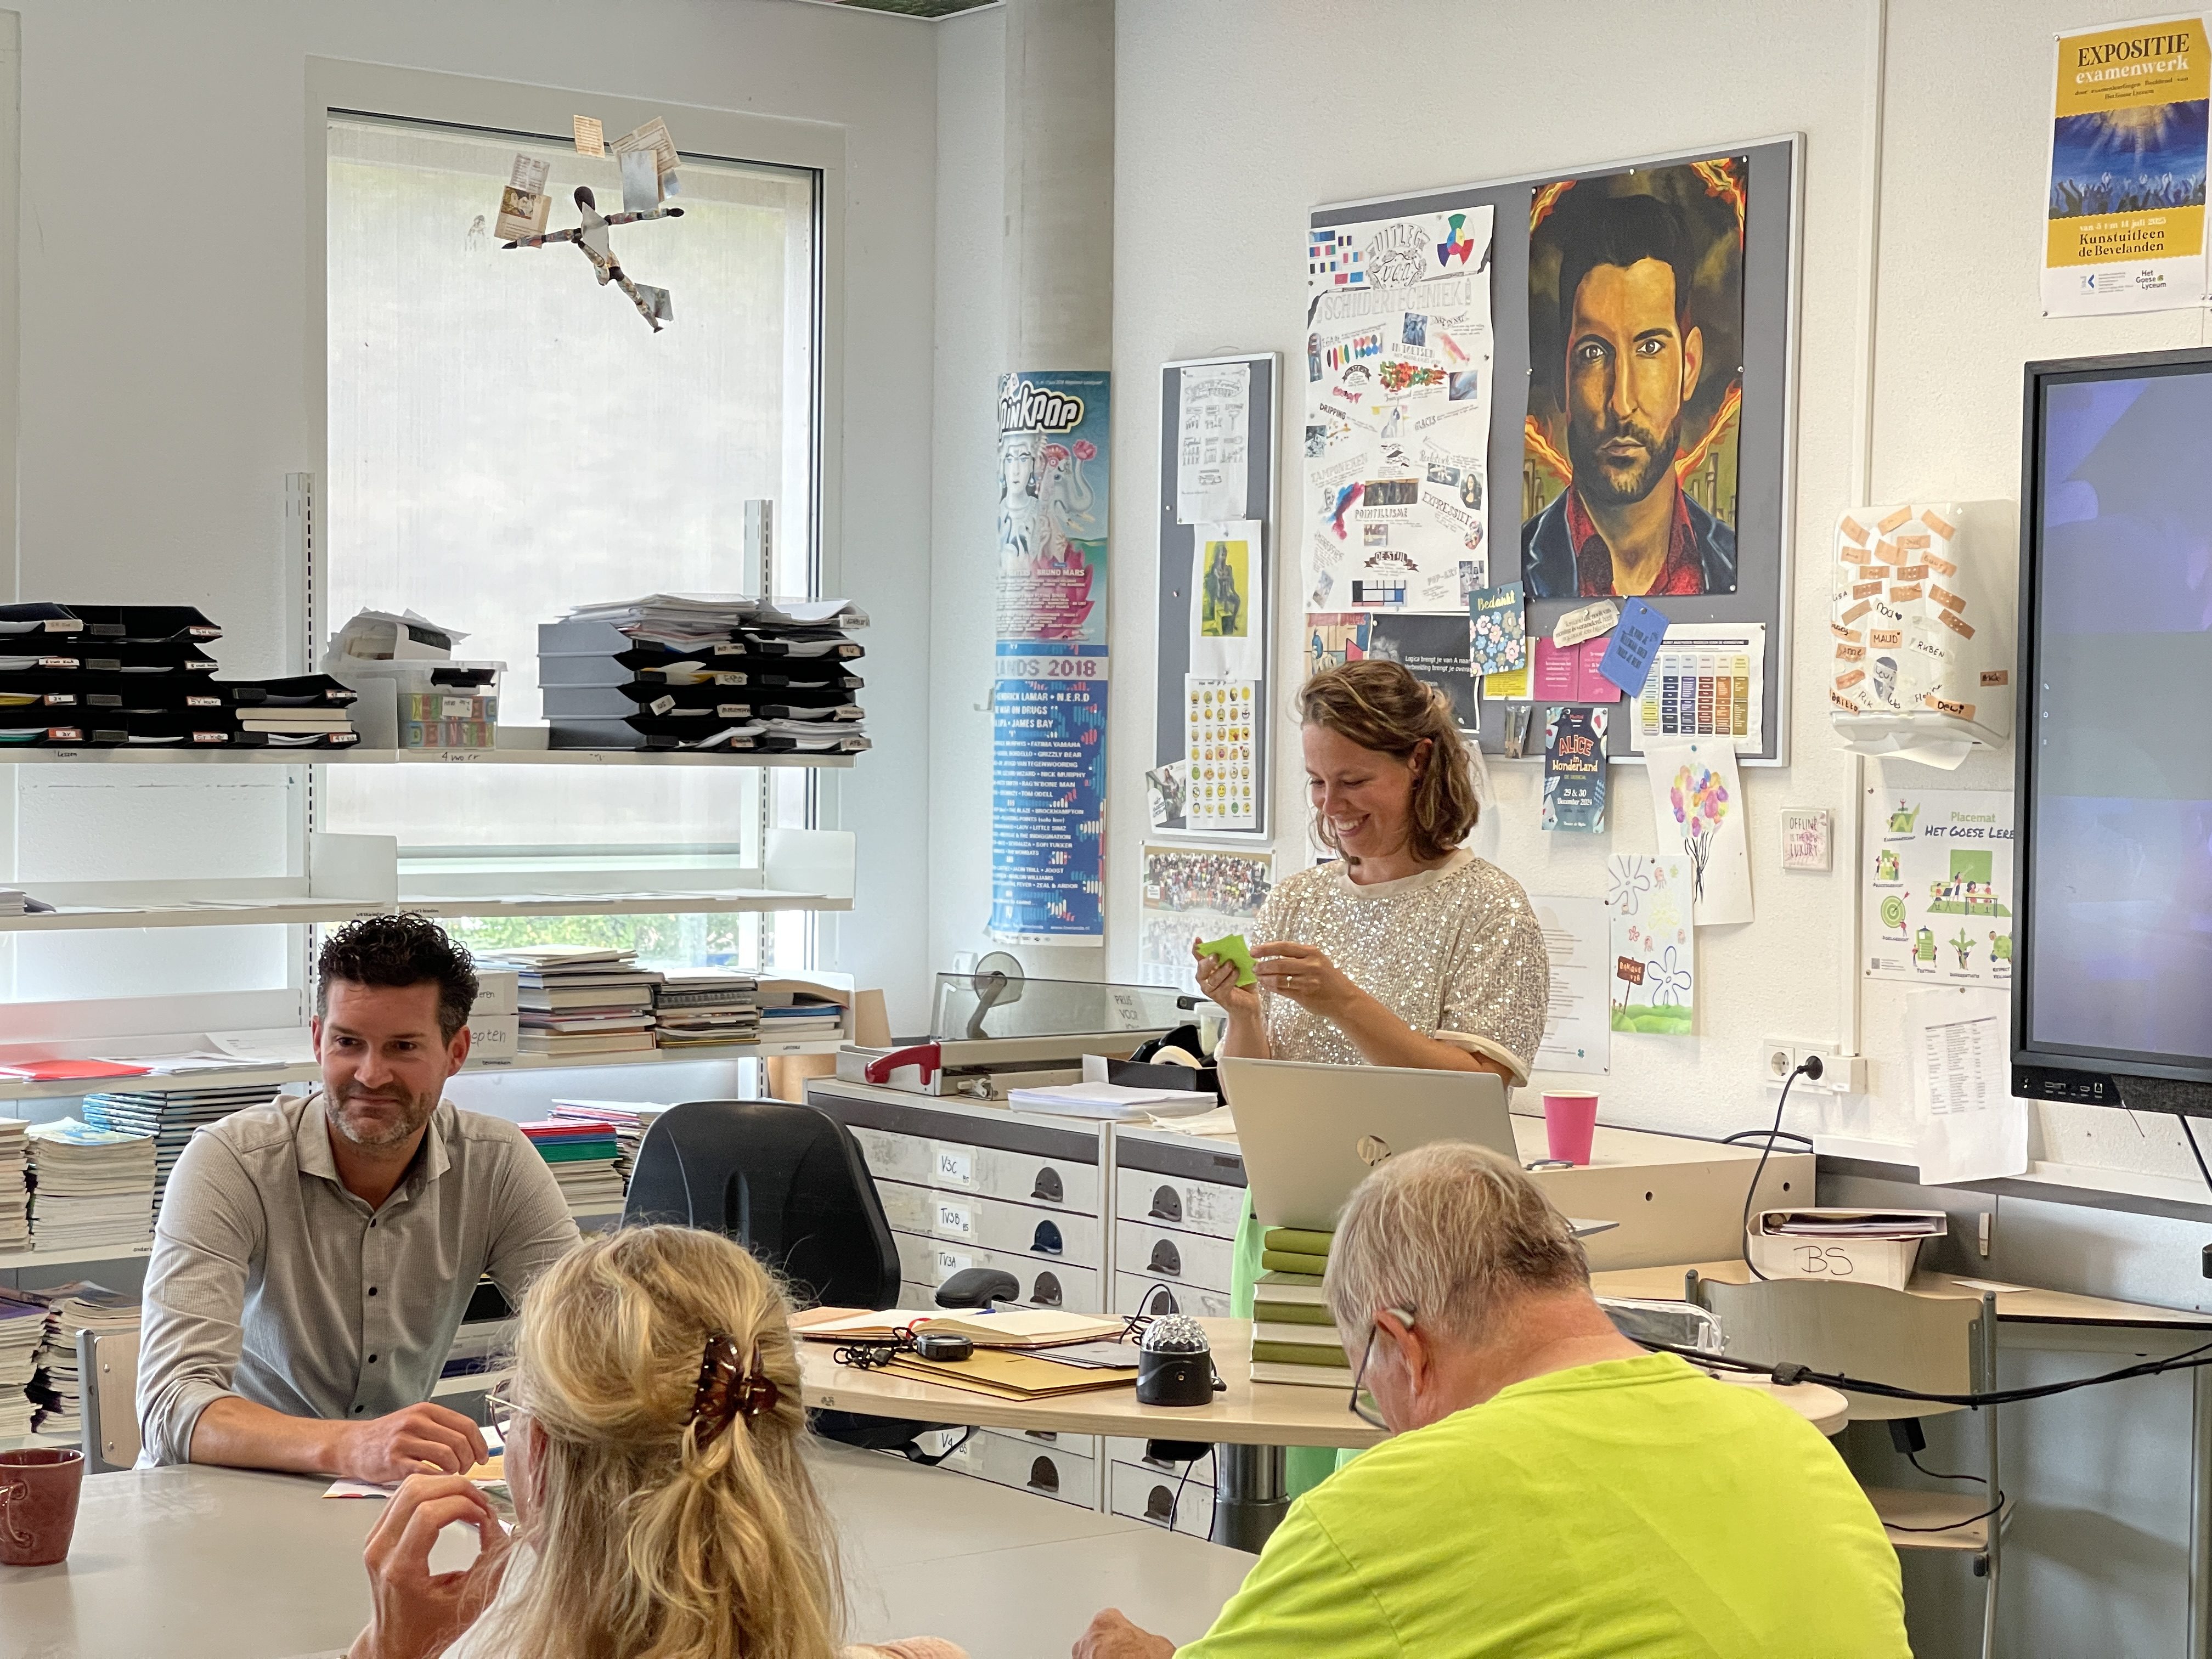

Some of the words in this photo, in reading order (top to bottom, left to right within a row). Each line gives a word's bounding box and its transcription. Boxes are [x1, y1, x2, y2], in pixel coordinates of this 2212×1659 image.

[2078, 33, 2190, 67] EXPOSITIE
[2076, 55, 2189, 83] examenwerk
[1374, 223, 1427, 252] UITLEG
[2079, 229, 2165, 245] Kunstuitleen
[2079, 247, 2092, 257] de
[2095, 241, 2164, 256] Bevelanden
[2142, 282, 2167, 291] Lyceum
[1324, 281, 1463, 320] SCHILDERTECHNIEK
[1319, 403, 1347, 420] DRIPPING
[1355, 508, 1408, 518] POINTILLISME
[1375, 552, 1385, 561] DE
[1477, 590, 1516, 611] Bedankt
[1874, 634, 1898, 644] MAUD
[1047, 659, 1097, 677] 2018
[1021, 693, 1048, 701] LAMAR
[1937, 701, 1964, 714] Dewi
[1012, 719, 1035, 727] JAMES
[1036, 719, 1054, 728] BAY
[1564, 788, 1572, 797] 29
[1578, 789, 1587, 797] 30
[1557, 797, 1580, 805] December
[1790, 816, 1818, 831] OFFLINE
[1951, 811, 1996, 823] Placemat
[1790, 833, 1795, 842] IS
[1925, 825, 1948, 837] HET
[1949, 826, 1985, 838] GOESE
[1790, 843, 1818, 858] LUXURY
[1119, 1009, 1139, 1020] VOOR
[941, 1155, 957, 1174] V3C
[940, 1207, 961, 1225] TV3B
[939, 1252, 957, 1268] TV3A
[1793, 1245, 1854, 1276] BS
